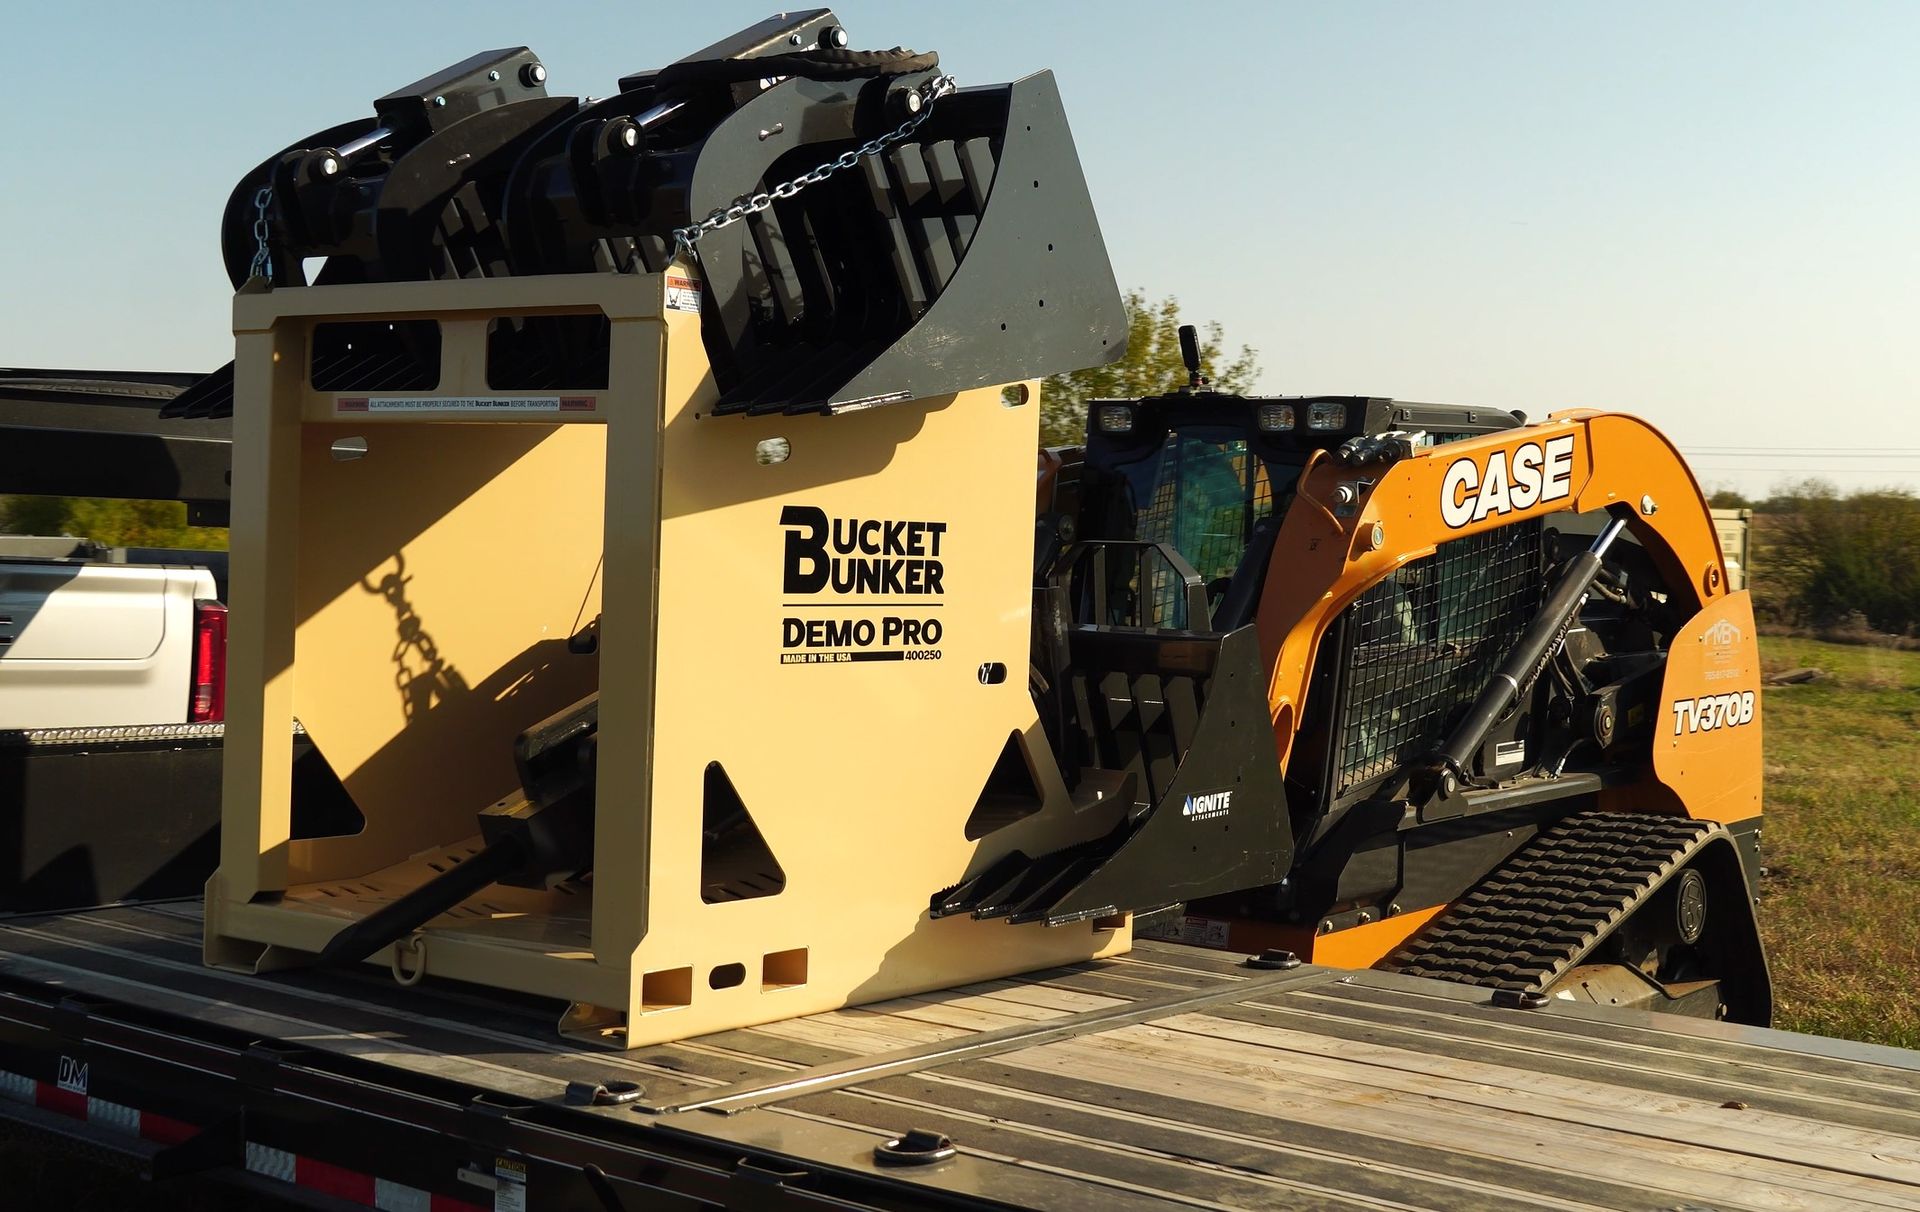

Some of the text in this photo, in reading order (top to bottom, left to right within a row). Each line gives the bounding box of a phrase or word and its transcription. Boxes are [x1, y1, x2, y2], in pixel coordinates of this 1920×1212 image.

[377, 400, 404, 408] ATTACHMENTS
[404, 400, 416, 408] MUST
[422, 400, 441, 408] PROPERLY
[442, 400, 460, 408] SECURED
[460, 400, 466, 408] TO
[466, 400, 475, 408] THE
[510, 400, 526, 408] BEFORE
[526, 400, 558, 408] TRANSPORTING
[1440, 433, 1575, 529] CASE
[779, 505, 947, 556] BUCKET
[782, 546, 945, 595] BUNKER
[782, 616, 943, 648] DEMO PRO
[782, 650, 942, 663] MADE IN THE USA 400250
[1673, 690, 1755, 736] TV370B
[1191, 809, 1229, 821] ATTACHMENTS
[1192, 791, 1231, 814] IGNITE
[58, 1055, 88, 1087] DM
